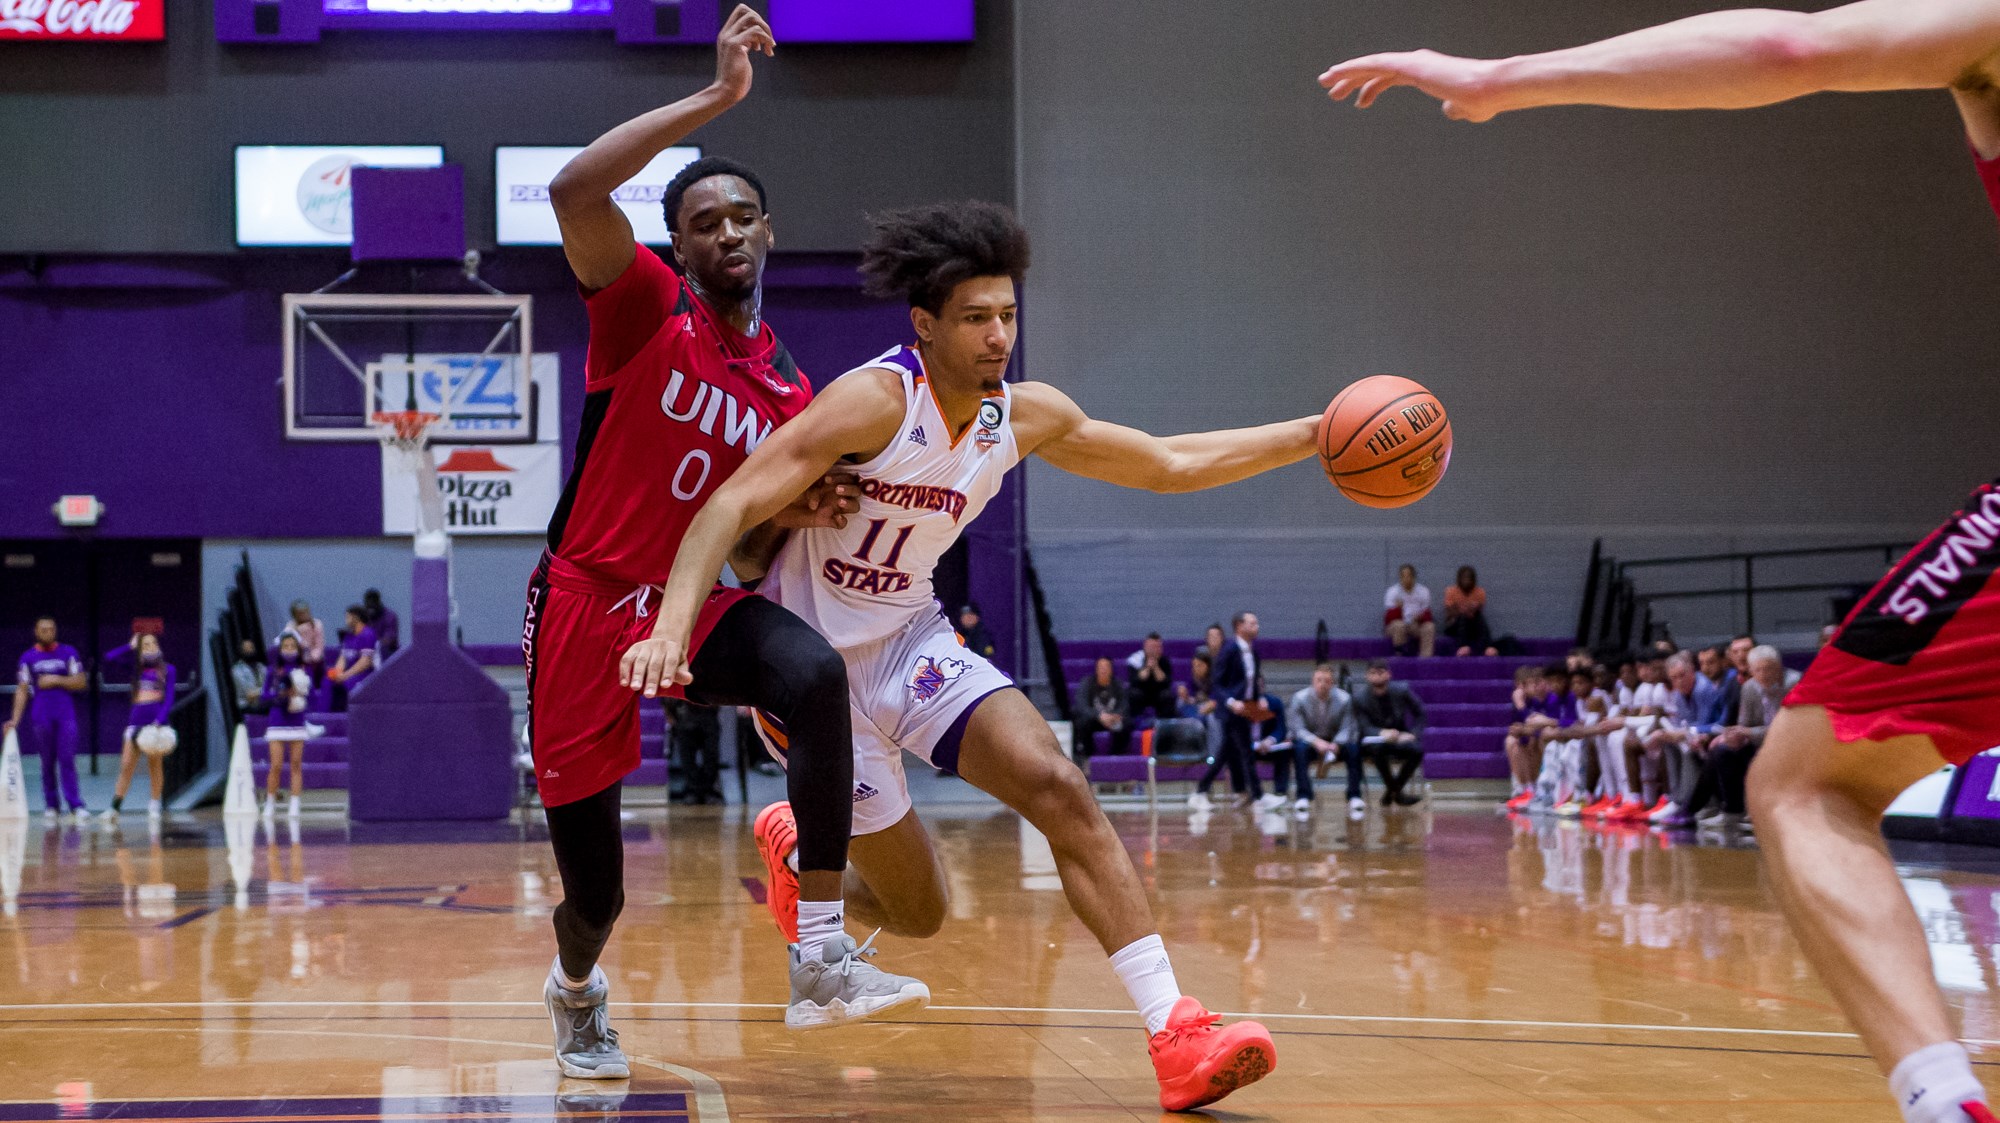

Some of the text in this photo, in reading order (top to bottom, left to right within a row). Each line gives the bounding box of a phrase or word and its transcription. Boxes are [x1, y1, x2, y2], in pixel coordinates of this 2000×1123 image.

[660, 368, 774, 456] UIW
[1364, 401, 1442, 456] THE ROCK
[671, 449, 711, 501] 0
[444, 500, 497, 526] Hut
[851, 518, 917, 570] 11
[1887, 486, 2000, 625] DINALS
[823, 558, 914, 594] STATE
